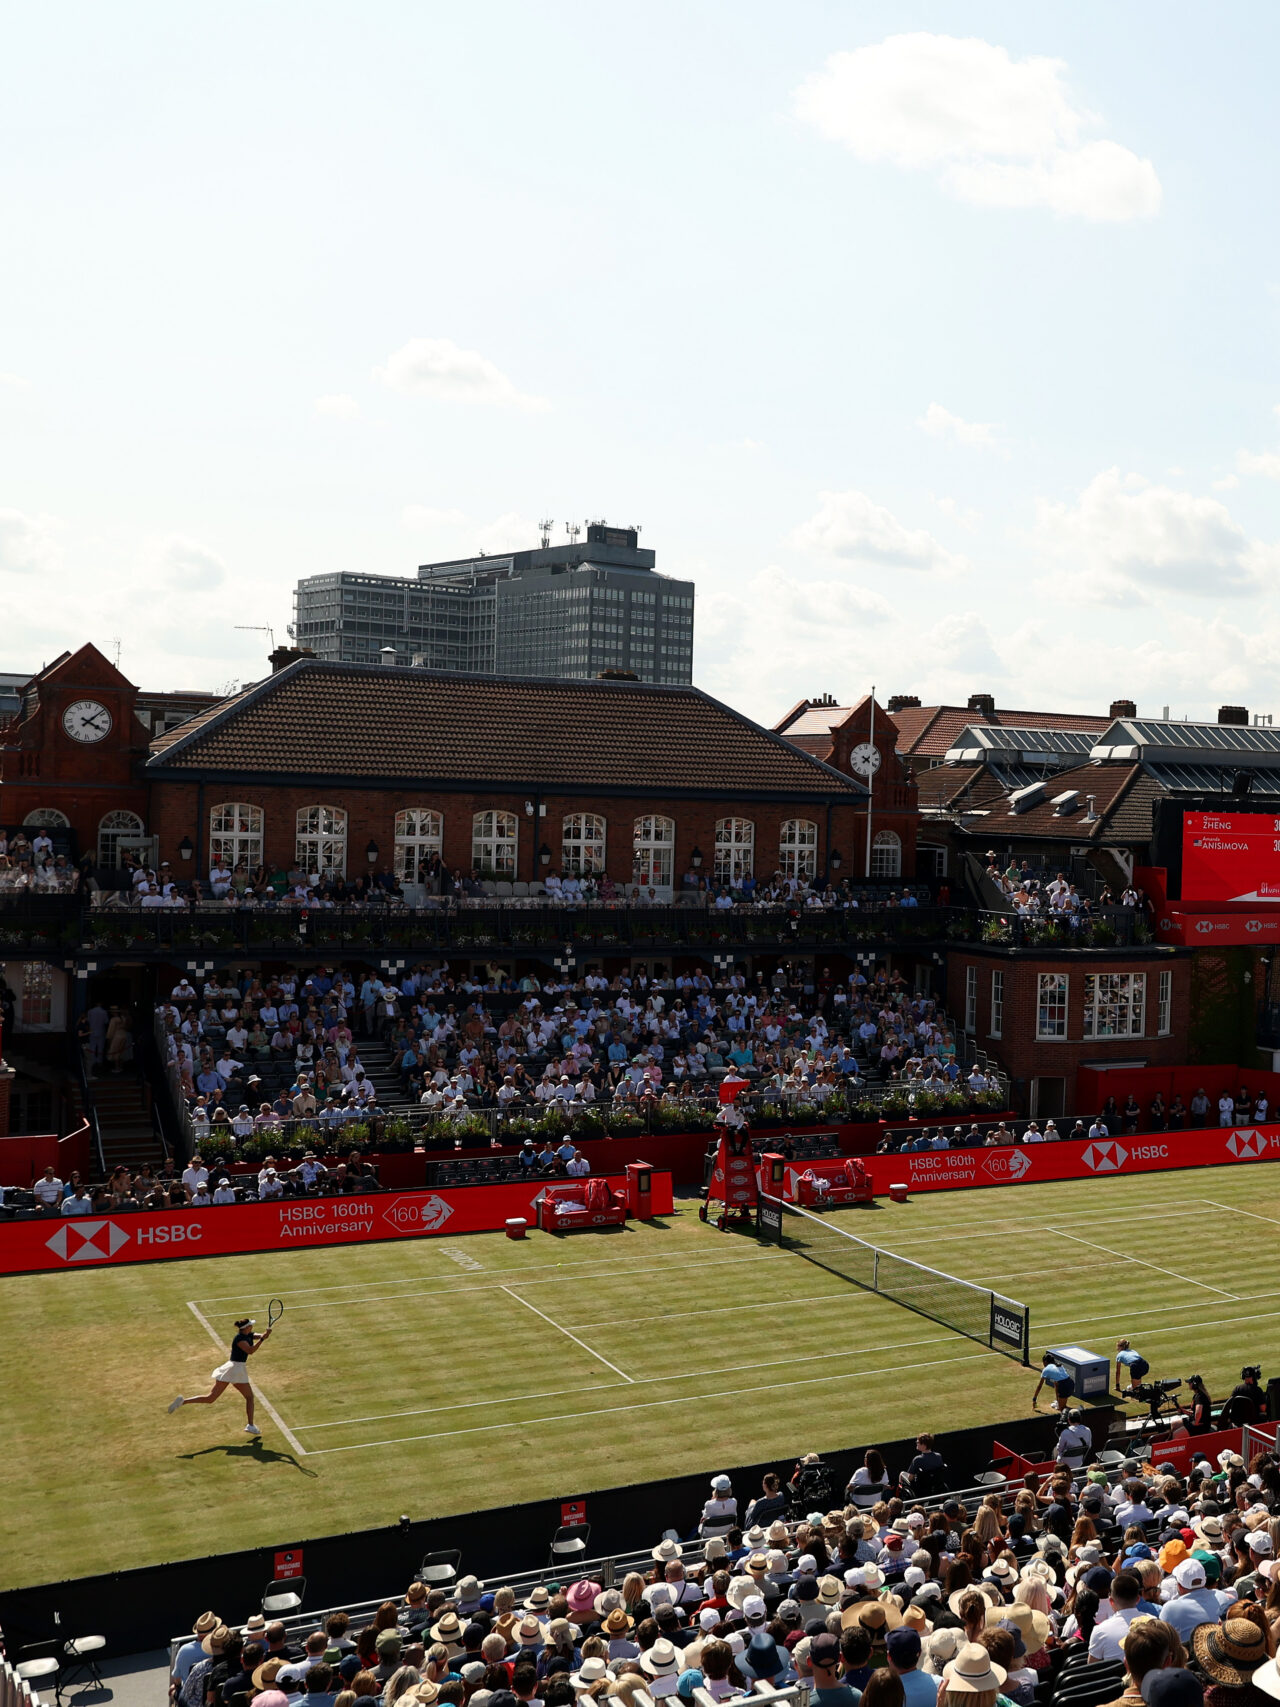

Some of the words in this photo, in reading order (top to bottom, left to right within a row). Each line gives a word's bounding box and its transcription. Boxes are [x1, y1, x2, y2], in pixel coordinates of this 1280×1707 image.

[1202, 822, 1232, 830] ZHENG
[1202, 842, 1248, 850] ANISIMOVA
[1131, 1144, 1168, 1160] HSBC
[909, 1157, 942, 1170] HSBC
[946, 1155, 975, 1167] 160th
[988, 1158, 1008, 1172] 160
[910, 1170, 976, 1183] Anniversary
[279, 1206, 326, 1222] HSBC
[332, 1202, 374, 1218] 160th
[391, 1206, 418, 1222] 160
[137, 1224, 202, 1245] HSBC
[280, 1220, 374, 1238] Anniversary
[994, 1312, 1020, 1333] HOLOGIC
